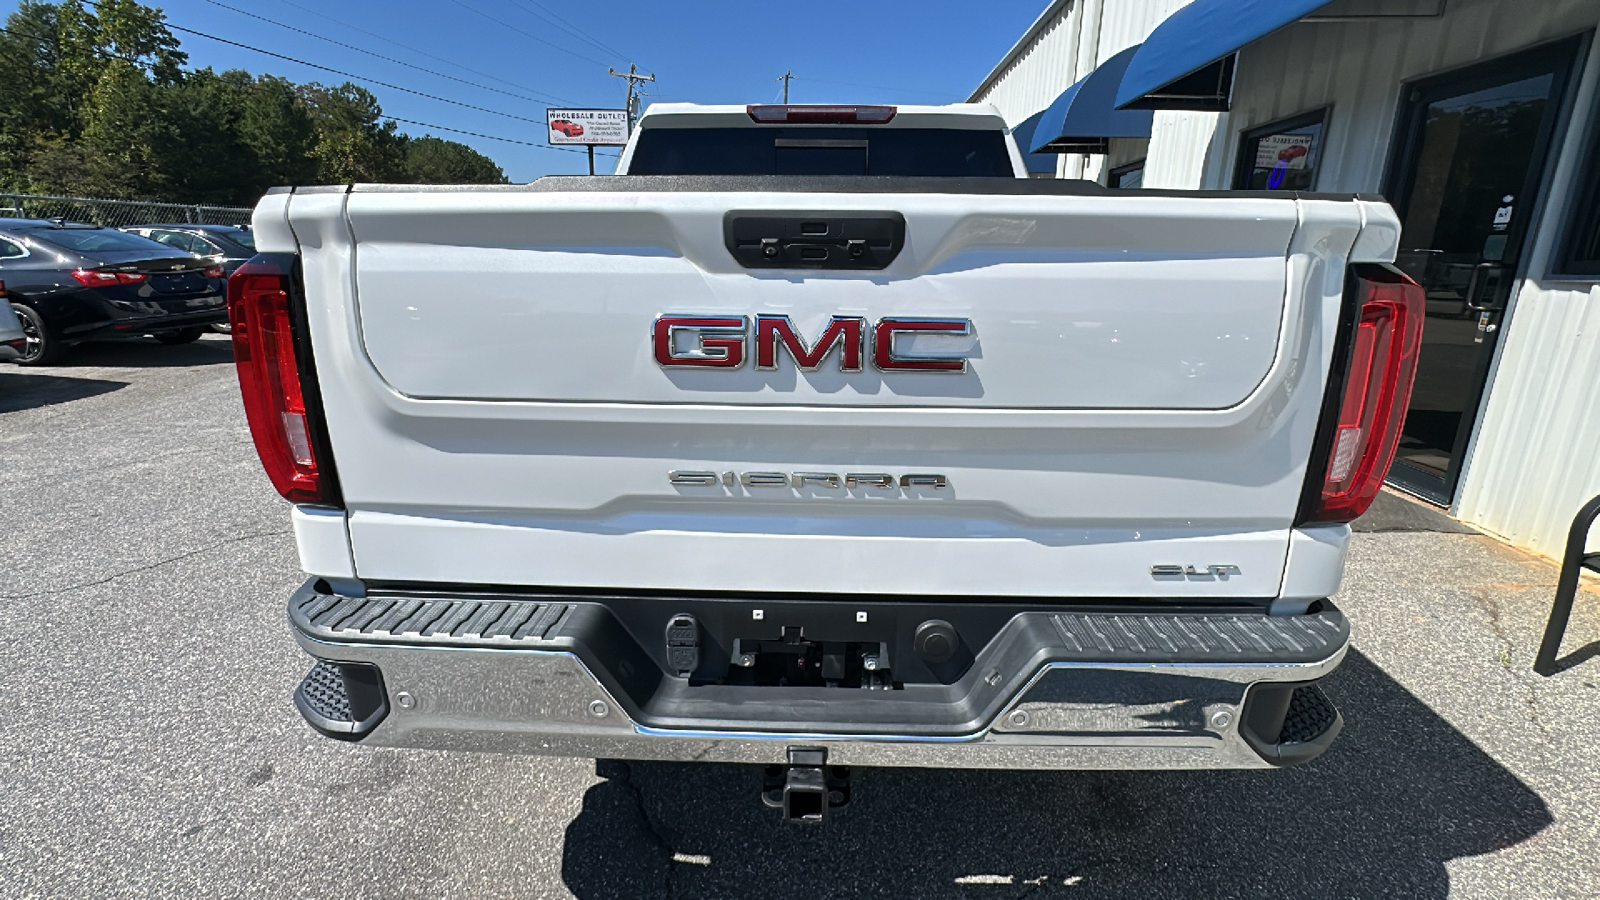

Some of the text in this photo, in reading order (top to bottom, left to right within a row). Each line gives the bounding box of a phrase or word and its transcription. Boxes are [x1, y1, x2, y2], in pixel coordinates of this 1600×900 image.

[652, 313, 972, 374] GMC
[668, 469, 947, 490] SIERRA
[1149, 564, 1239, 576] SLT
